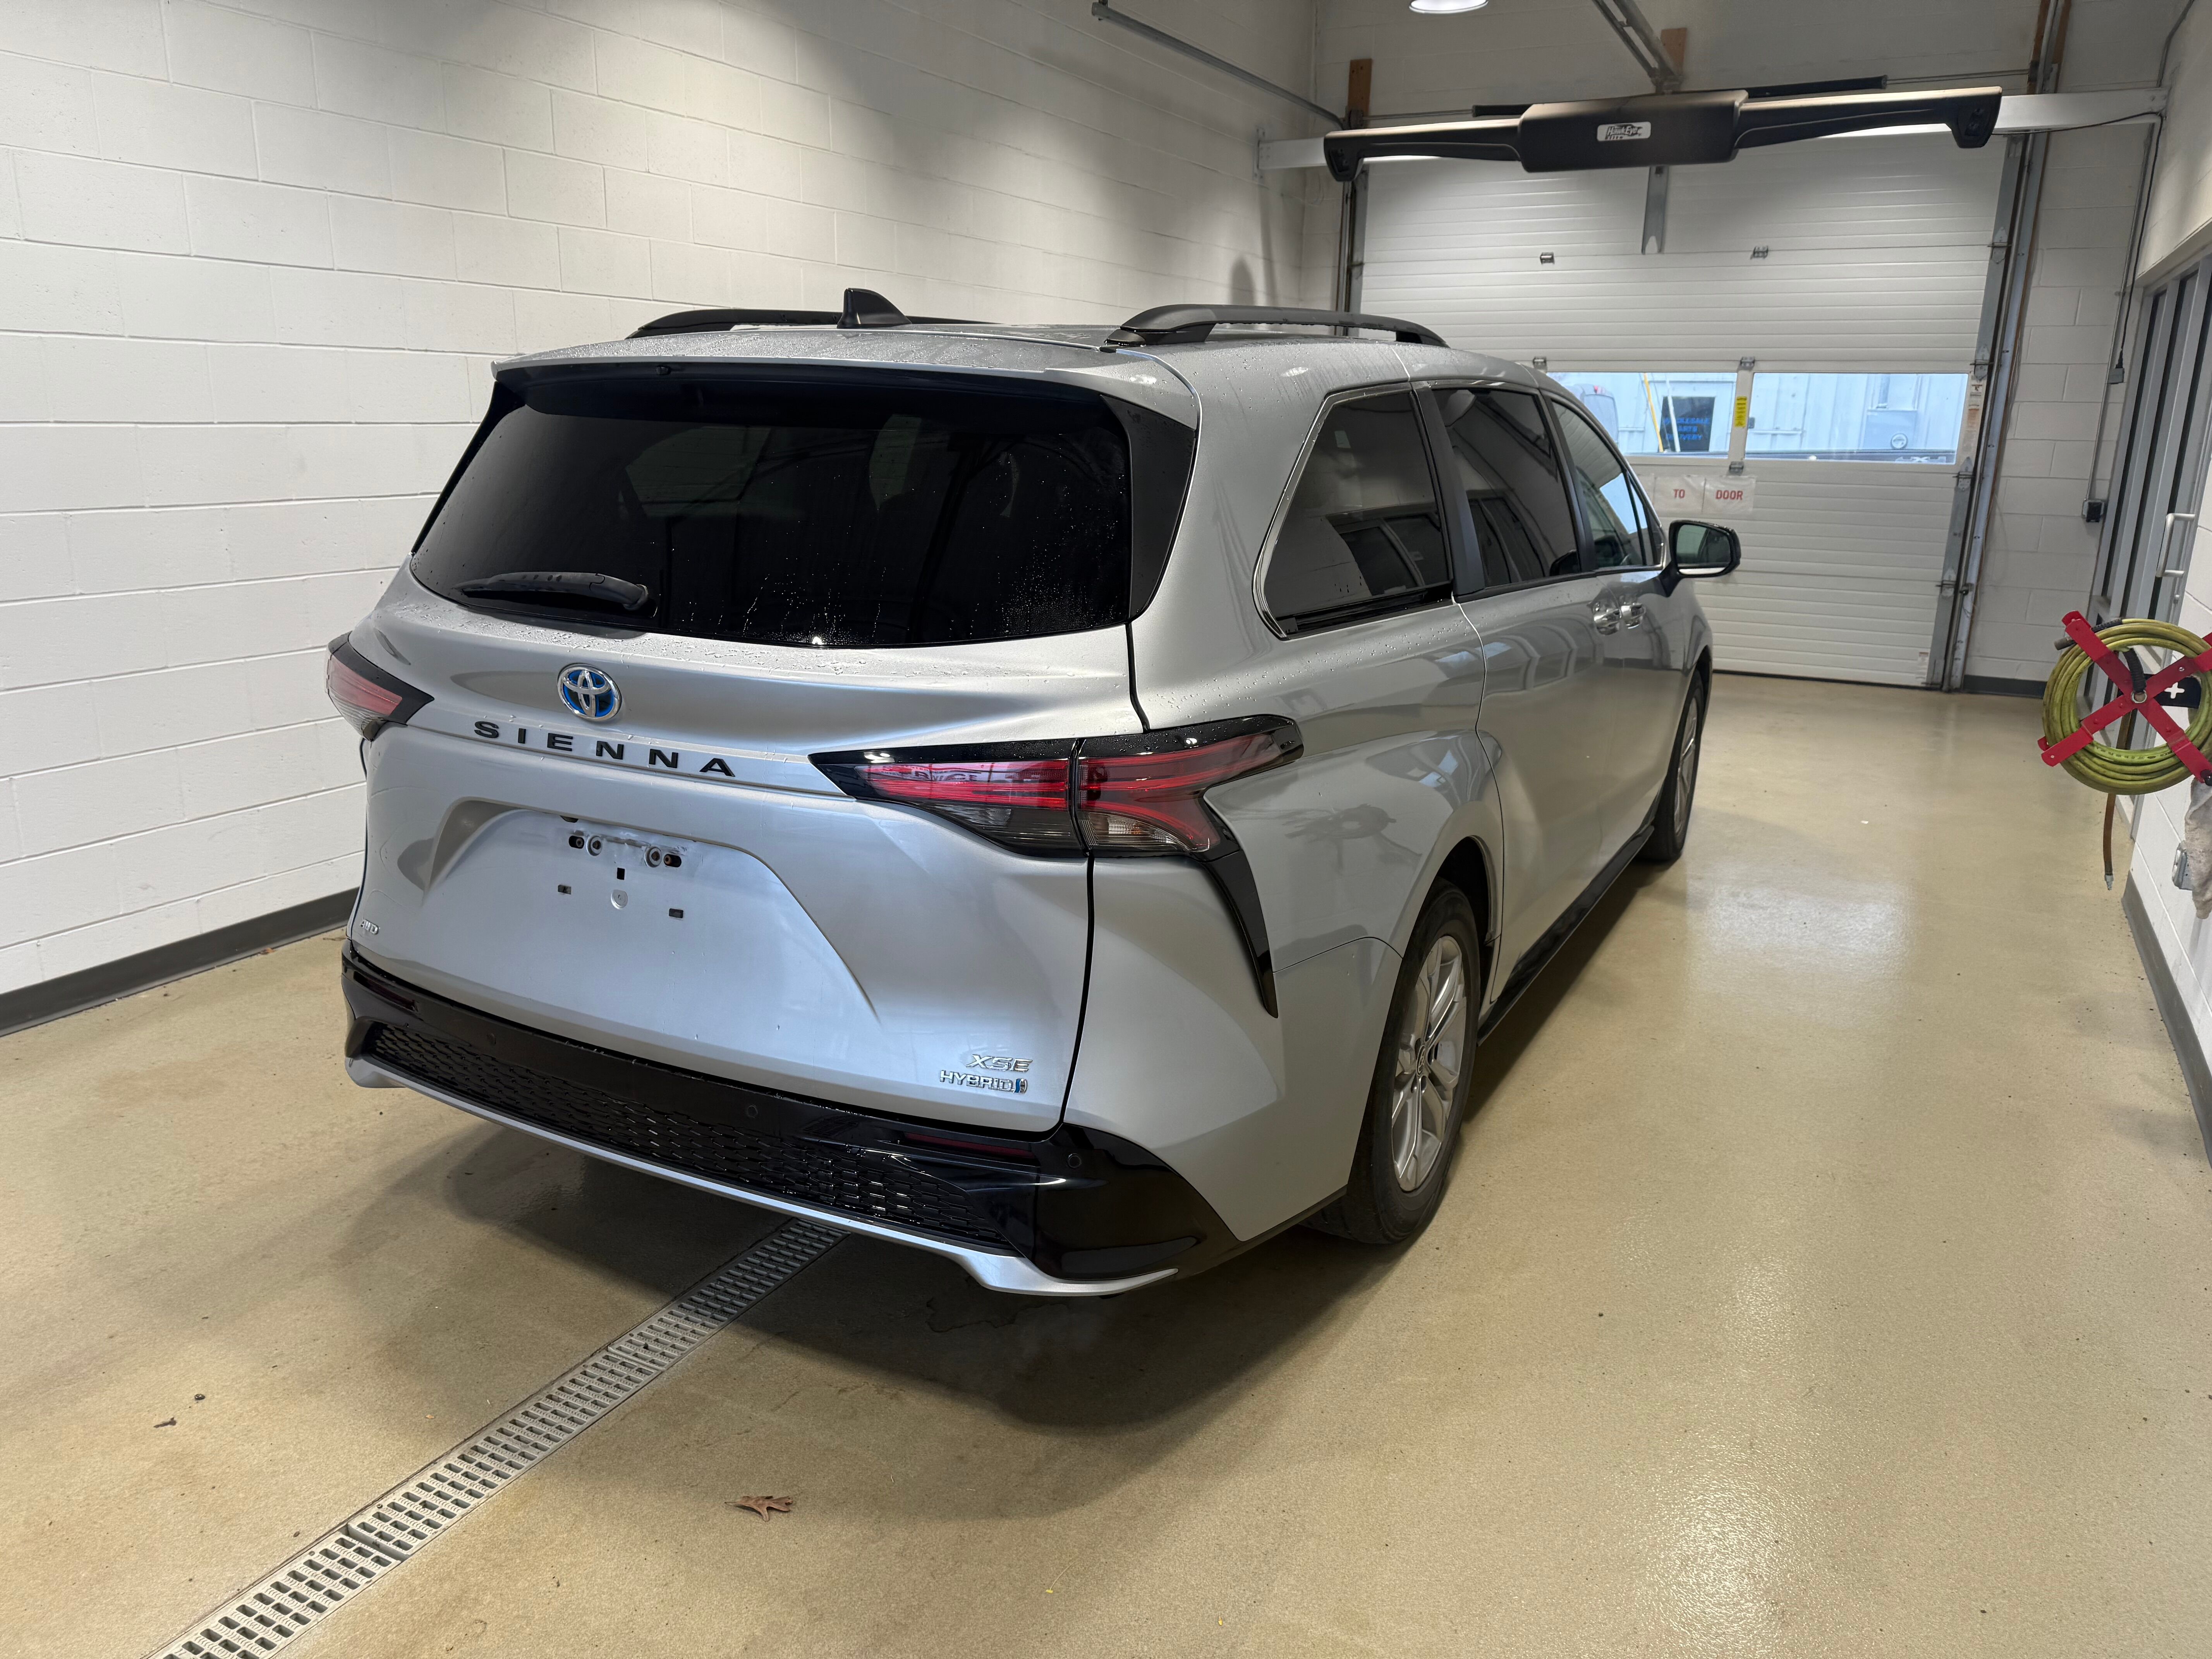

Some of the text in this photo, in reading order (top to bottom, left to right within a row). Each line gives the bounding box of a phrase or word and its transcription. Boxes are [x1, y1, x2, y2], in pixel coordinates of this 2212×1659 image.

[1673, 489, 1743, 501] TO DOOR
[474, 721, 735, 777] SIENNA
[965, 1054, 1034, 1073] XSE
[939, 1070, 1013, 1092] HYBRID
